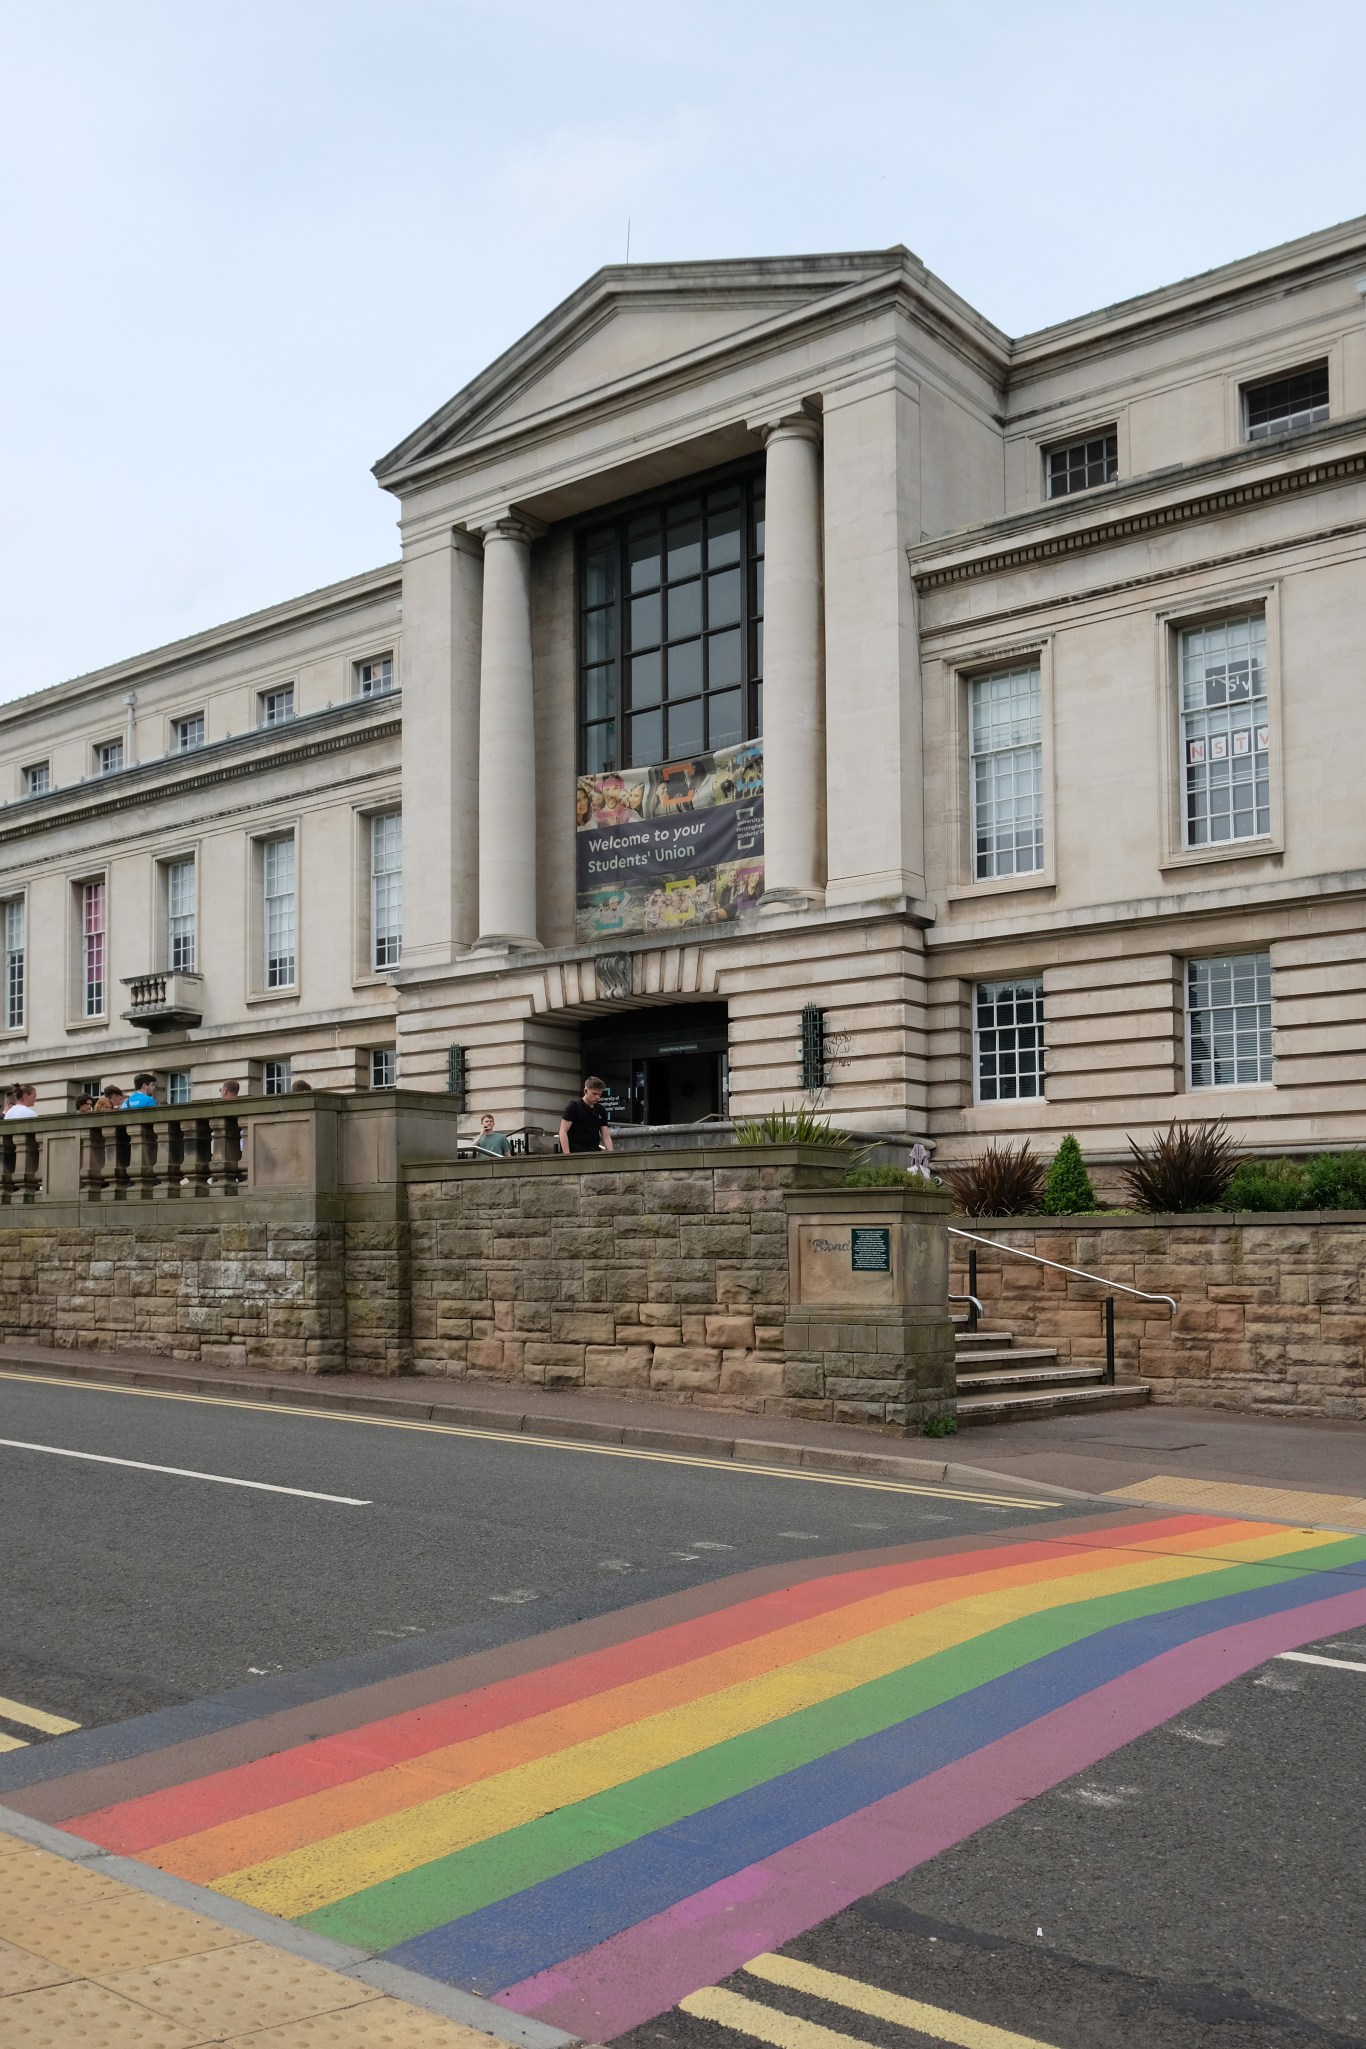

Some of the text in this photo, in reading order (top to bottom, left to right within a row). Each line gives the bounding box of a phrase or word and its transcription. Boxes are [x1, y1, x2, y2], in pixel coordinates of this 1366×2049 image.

[1191, 733, 1269, 759] NSTV
[588, 822, 706, 853] Welcome to your
[588, 844, 695, 873] Students' Union
